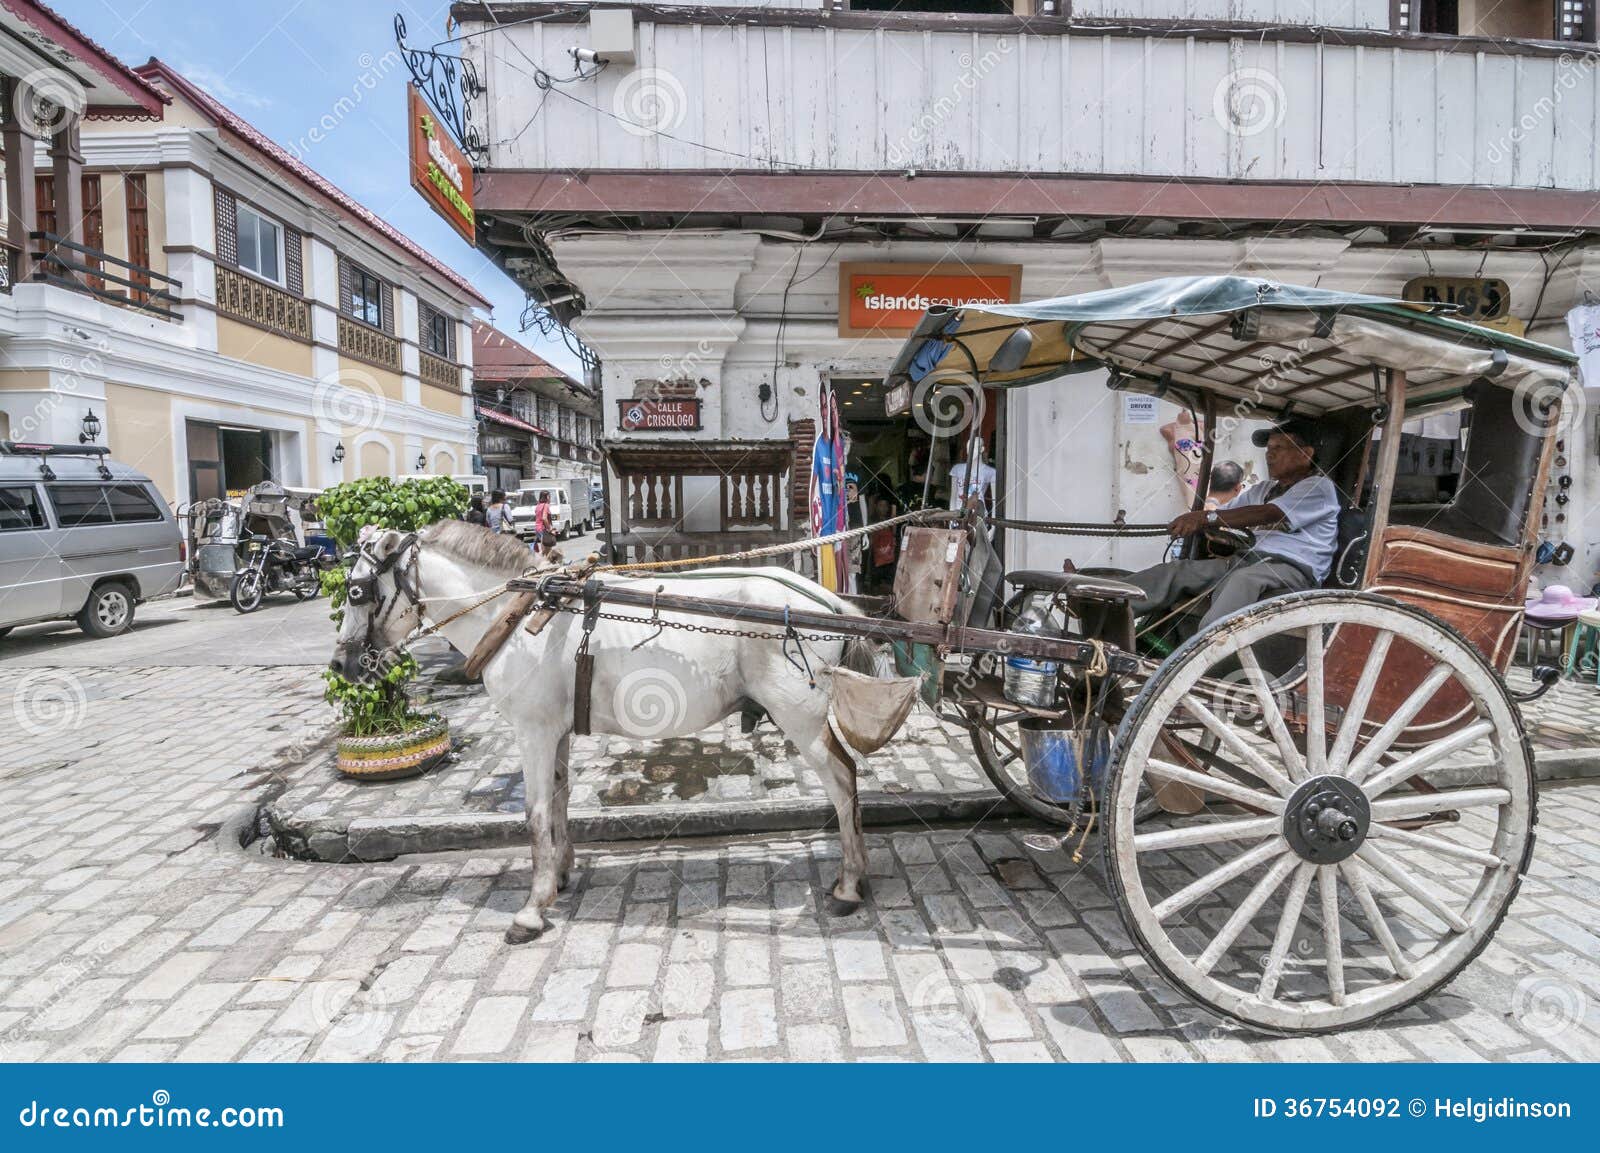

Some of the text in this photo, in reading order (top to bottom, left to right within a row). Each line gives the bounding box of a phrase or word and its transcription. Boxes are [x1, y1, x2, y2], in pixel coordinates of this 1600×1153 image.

[865, 293, 929, 311] islands
[657, 403, 682, 413] CALLE
[647, 414, 694, 427] CRISOLOGO
